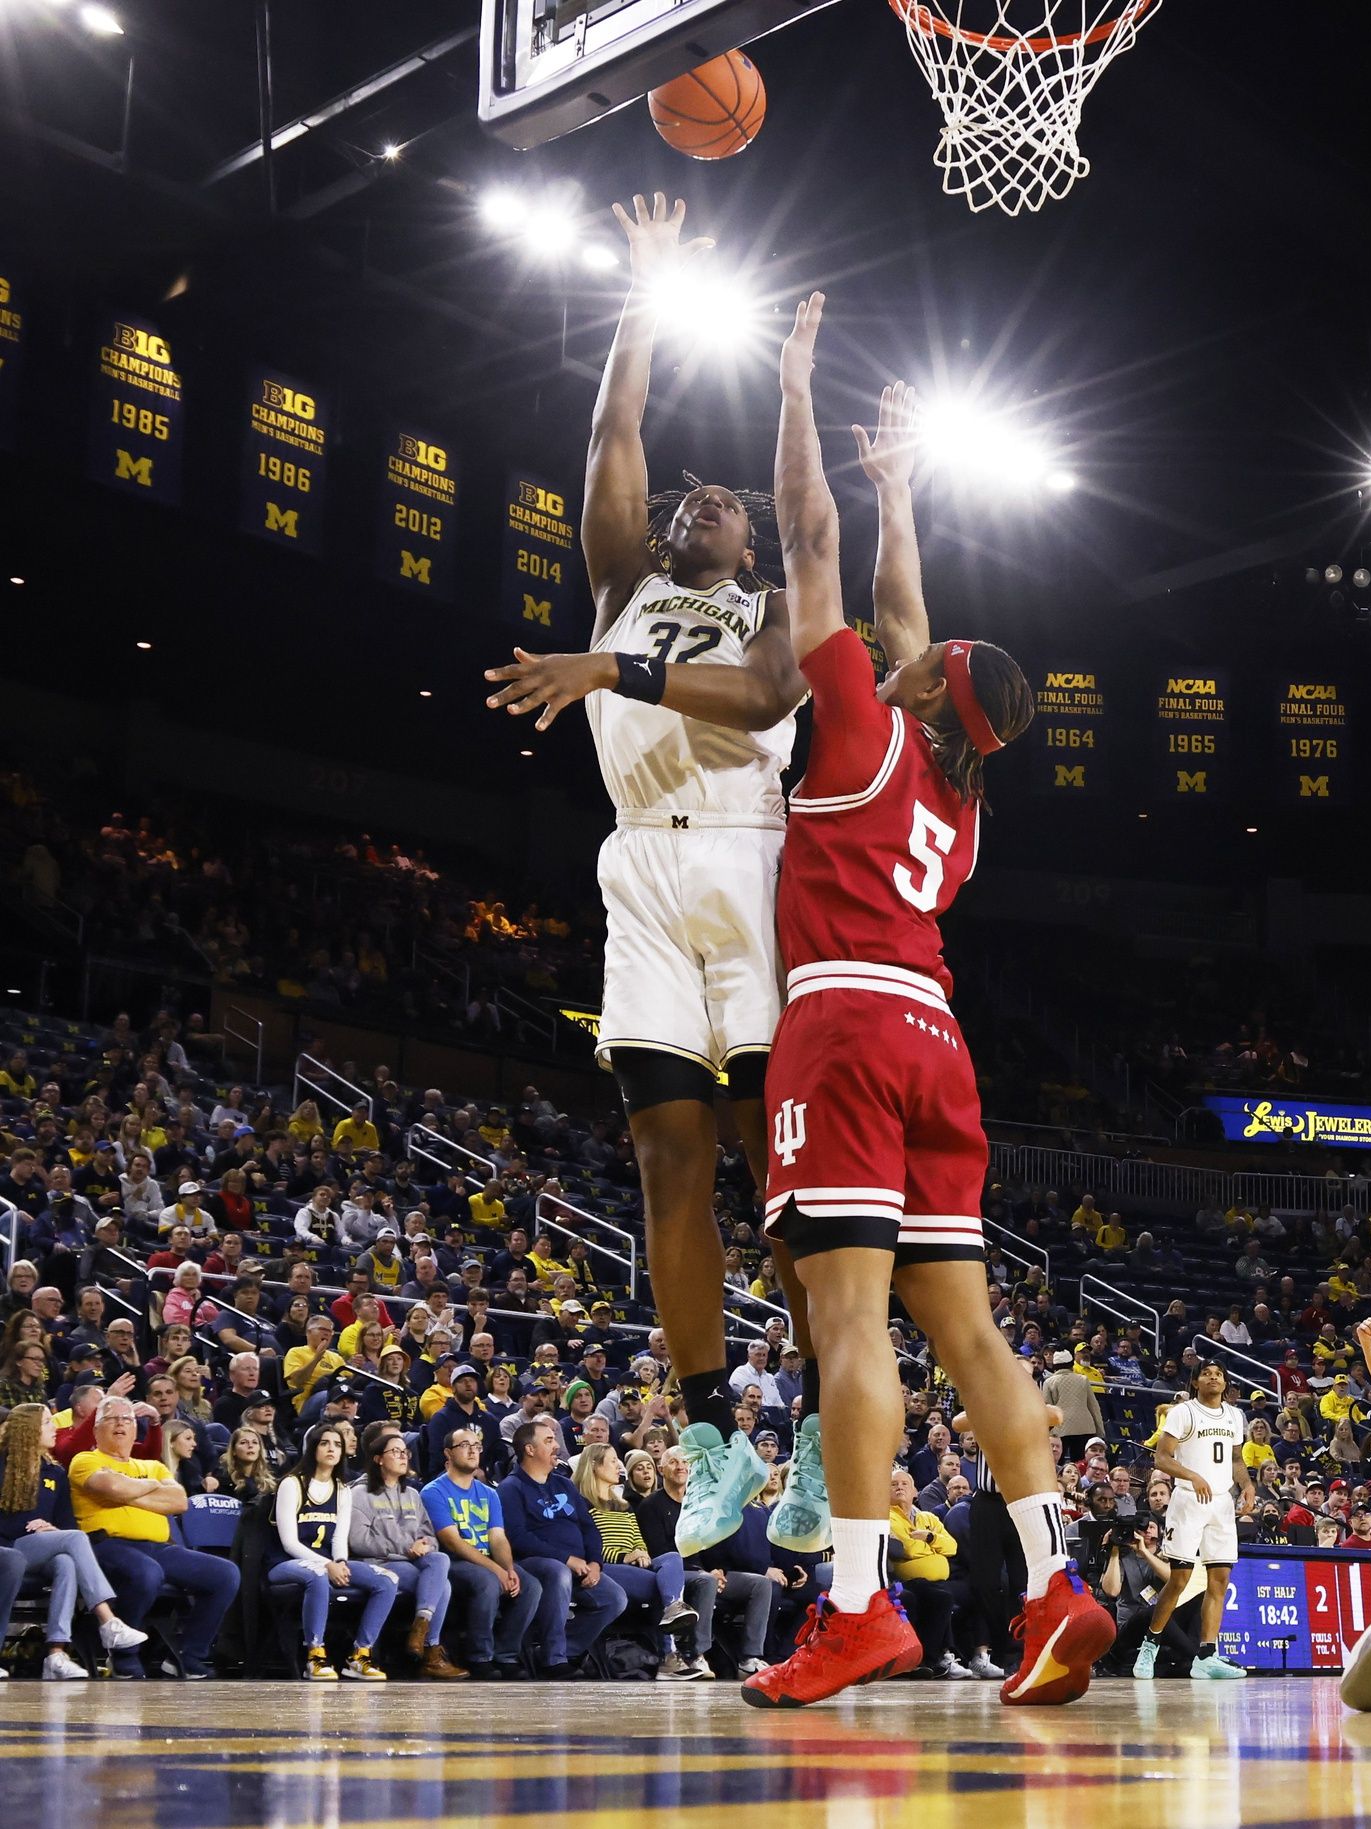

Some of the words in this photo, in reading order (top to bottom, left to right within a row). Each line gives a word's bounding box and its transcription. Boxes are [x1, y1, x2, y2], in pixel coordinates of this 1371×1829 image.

[101, 347, 182, 389] CHAMPIONS
[112, 399, 170, 441] 1985
[252, 404, 325, 444] CHAMPIONS
[115, 449, 154, 487] M
[258, 453, 311, 493] 1986
[388, 455, 456, 494] CHAMPIONS
[265, 502, 298, 538] M
[395, 503, 442, 541] 2012
[509, 503, 573, 538] CHAMPIONS
[400, 550, 431, 585] M
[516, 549, 562, 584] 2014
[522, 593, 552, 626] M
[638, 595, 751, 642] MICHIGAN
[649, 621, 723, 664] 32
[1046, 673, 1096, 689] NCAA
[1166, 679, 1216, 694] NCAA
[1037, 691, 1071, 704] FINAL
[1074, 693, 1104, 705] FOUR
[1288, 684, 1337, 700] NCAA
[1060, 706, 1104, 714] BASKETBALL
[1158, 697, 1191, 710] FINAL
[1195, 698, 1224, 711] FOUR
[1280, 702, 1313, 715] FINAL
[1316, 704, 1345, 715] FOUR
[1181, 712, 1224, 720] BASKETBALL
[1302, 717, 1346, 725] BASKETBALL
[1047, 728, 1095, 748] 1964
[1168, 734, 1215, 753] 1965
[1290, 739, 1337, 758] 1976
[1055, 764, 1085, 787] M
[1176, 771, 1207, 792] M
[1299, 775, 1329, 797] M
[671, 815, 689, 829] M
[893, 799, 957, 913] 5
[1197, 1428, 1235, 1439] MICHIGAN
[1213, 1441, 1224, 1464] 0
[208, 1497, 239, 1509] Ruoff
[1226, 1582, 1239, 1610] 2
[1274, 1586, 1297, 1599] HALF
[1315, 1585, 1328, 1612] 2
[1258, 1605, 1298, 1625] 18:42
[1219, 1632, 1241, 1643] FOULS
[1244, 1632, 1250, 1642] 0
[1311, 1633, 1333, 1643] FOULS
[1335, 1633, 1340, 1643] 1
[1224, 1645, 1239, 1655] TOL
[1241, 1645, 1246, 1655] 4
[1316, 1645, 1330, 1655] TOL
[1331, 1645, 1336, 1655] 4
